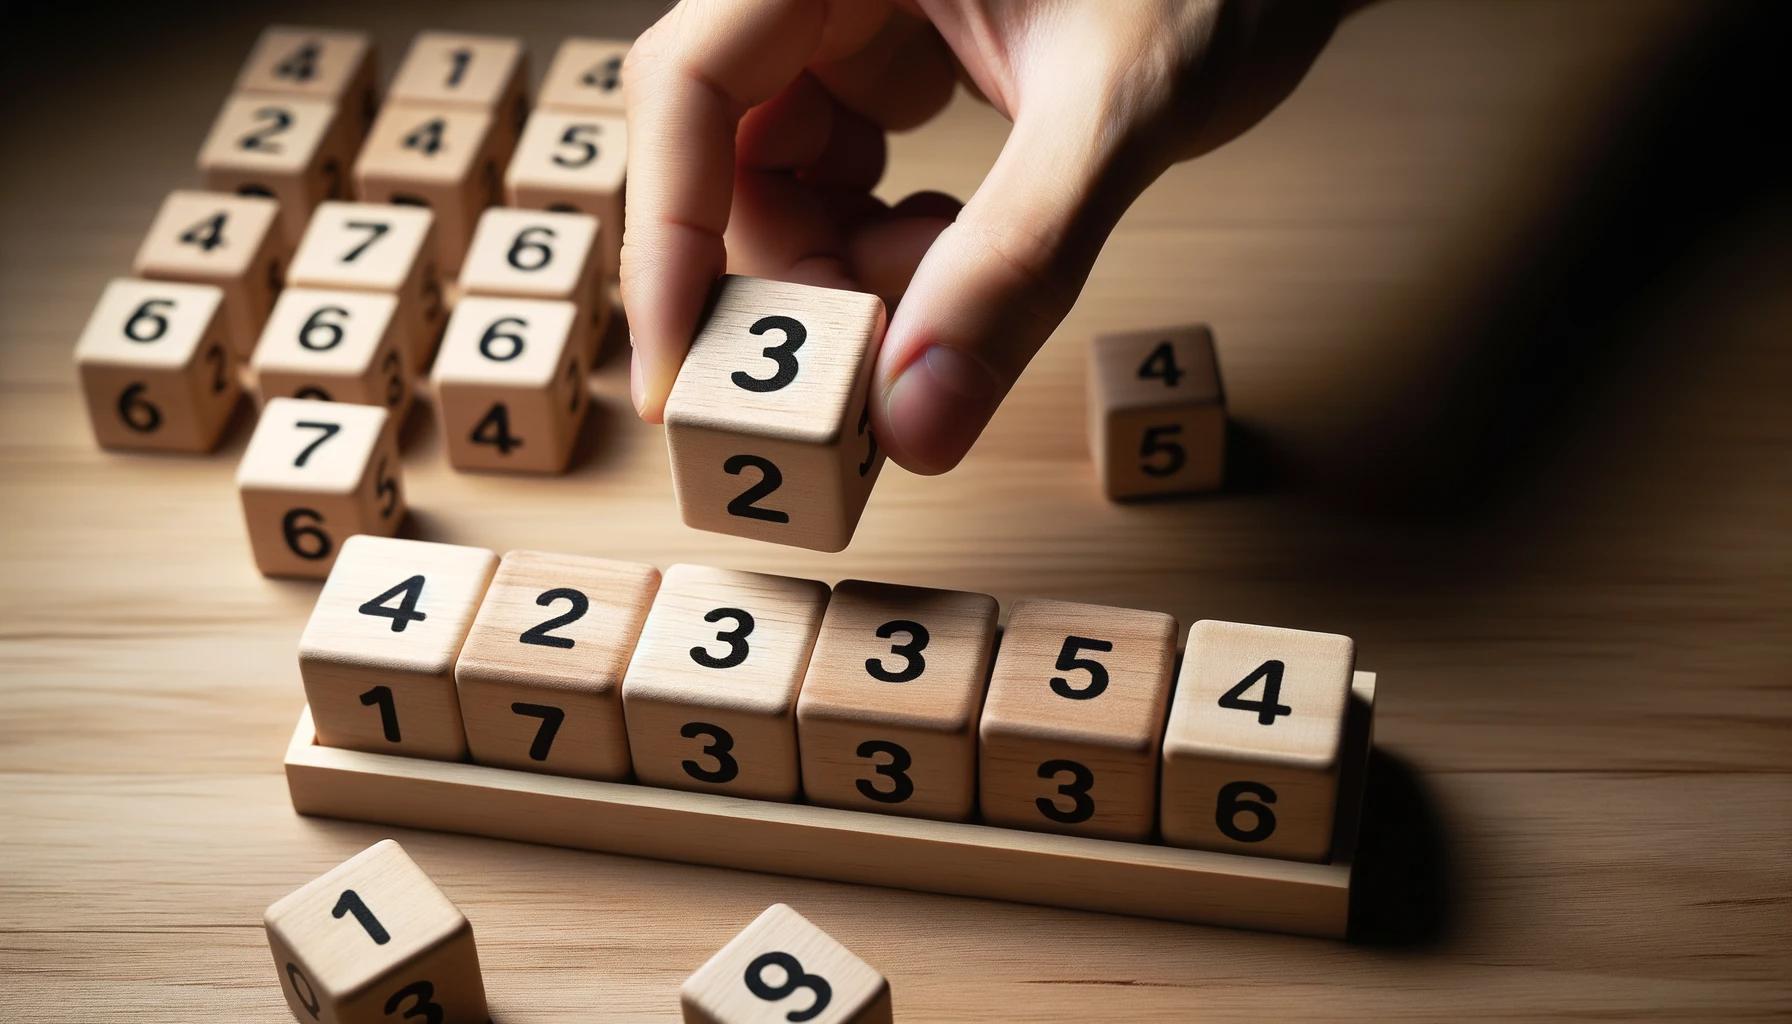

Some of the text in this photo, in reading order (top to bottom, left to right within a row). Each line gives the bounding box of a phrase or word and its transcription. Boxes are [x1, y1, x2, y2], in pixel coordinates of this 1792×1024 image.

[272, 39, 322, 82] 4
[442, 47, 473, 89] 1
[581, 56, 623, 92] 4
[238, 107, 294, 153] 2
[402, 118, 447, 156] 4
[551, 124, 603, 168] 5
[177, 213, 229, 252] 4
[341, 221, 390, 263] 7
[506, 227, 558, 272] 6
[123, 299, 175, 344] 6
[298, 306, 350, 352] 6
[478, 317, 530, 362] 6
[731, 315, 808, 393] 3
[1137, 342, 1185, 388] 4
[116, 383, 163, 434] 6
[471, 404, 522, 455] 4
[293, 421, 341, 468] 7
[1139, 425, 1187, 479] 5
[723, 454, 790, 524] 2
[282, 508, 332, 560] 6
[358, 574, 1291, 726] 4 2 3 3 5 4
[359, 685, 1277, 843] 1 7 3 3 3 6
[332, 889, 391, 946] 1
[384, 980, 443, 1024] 3
